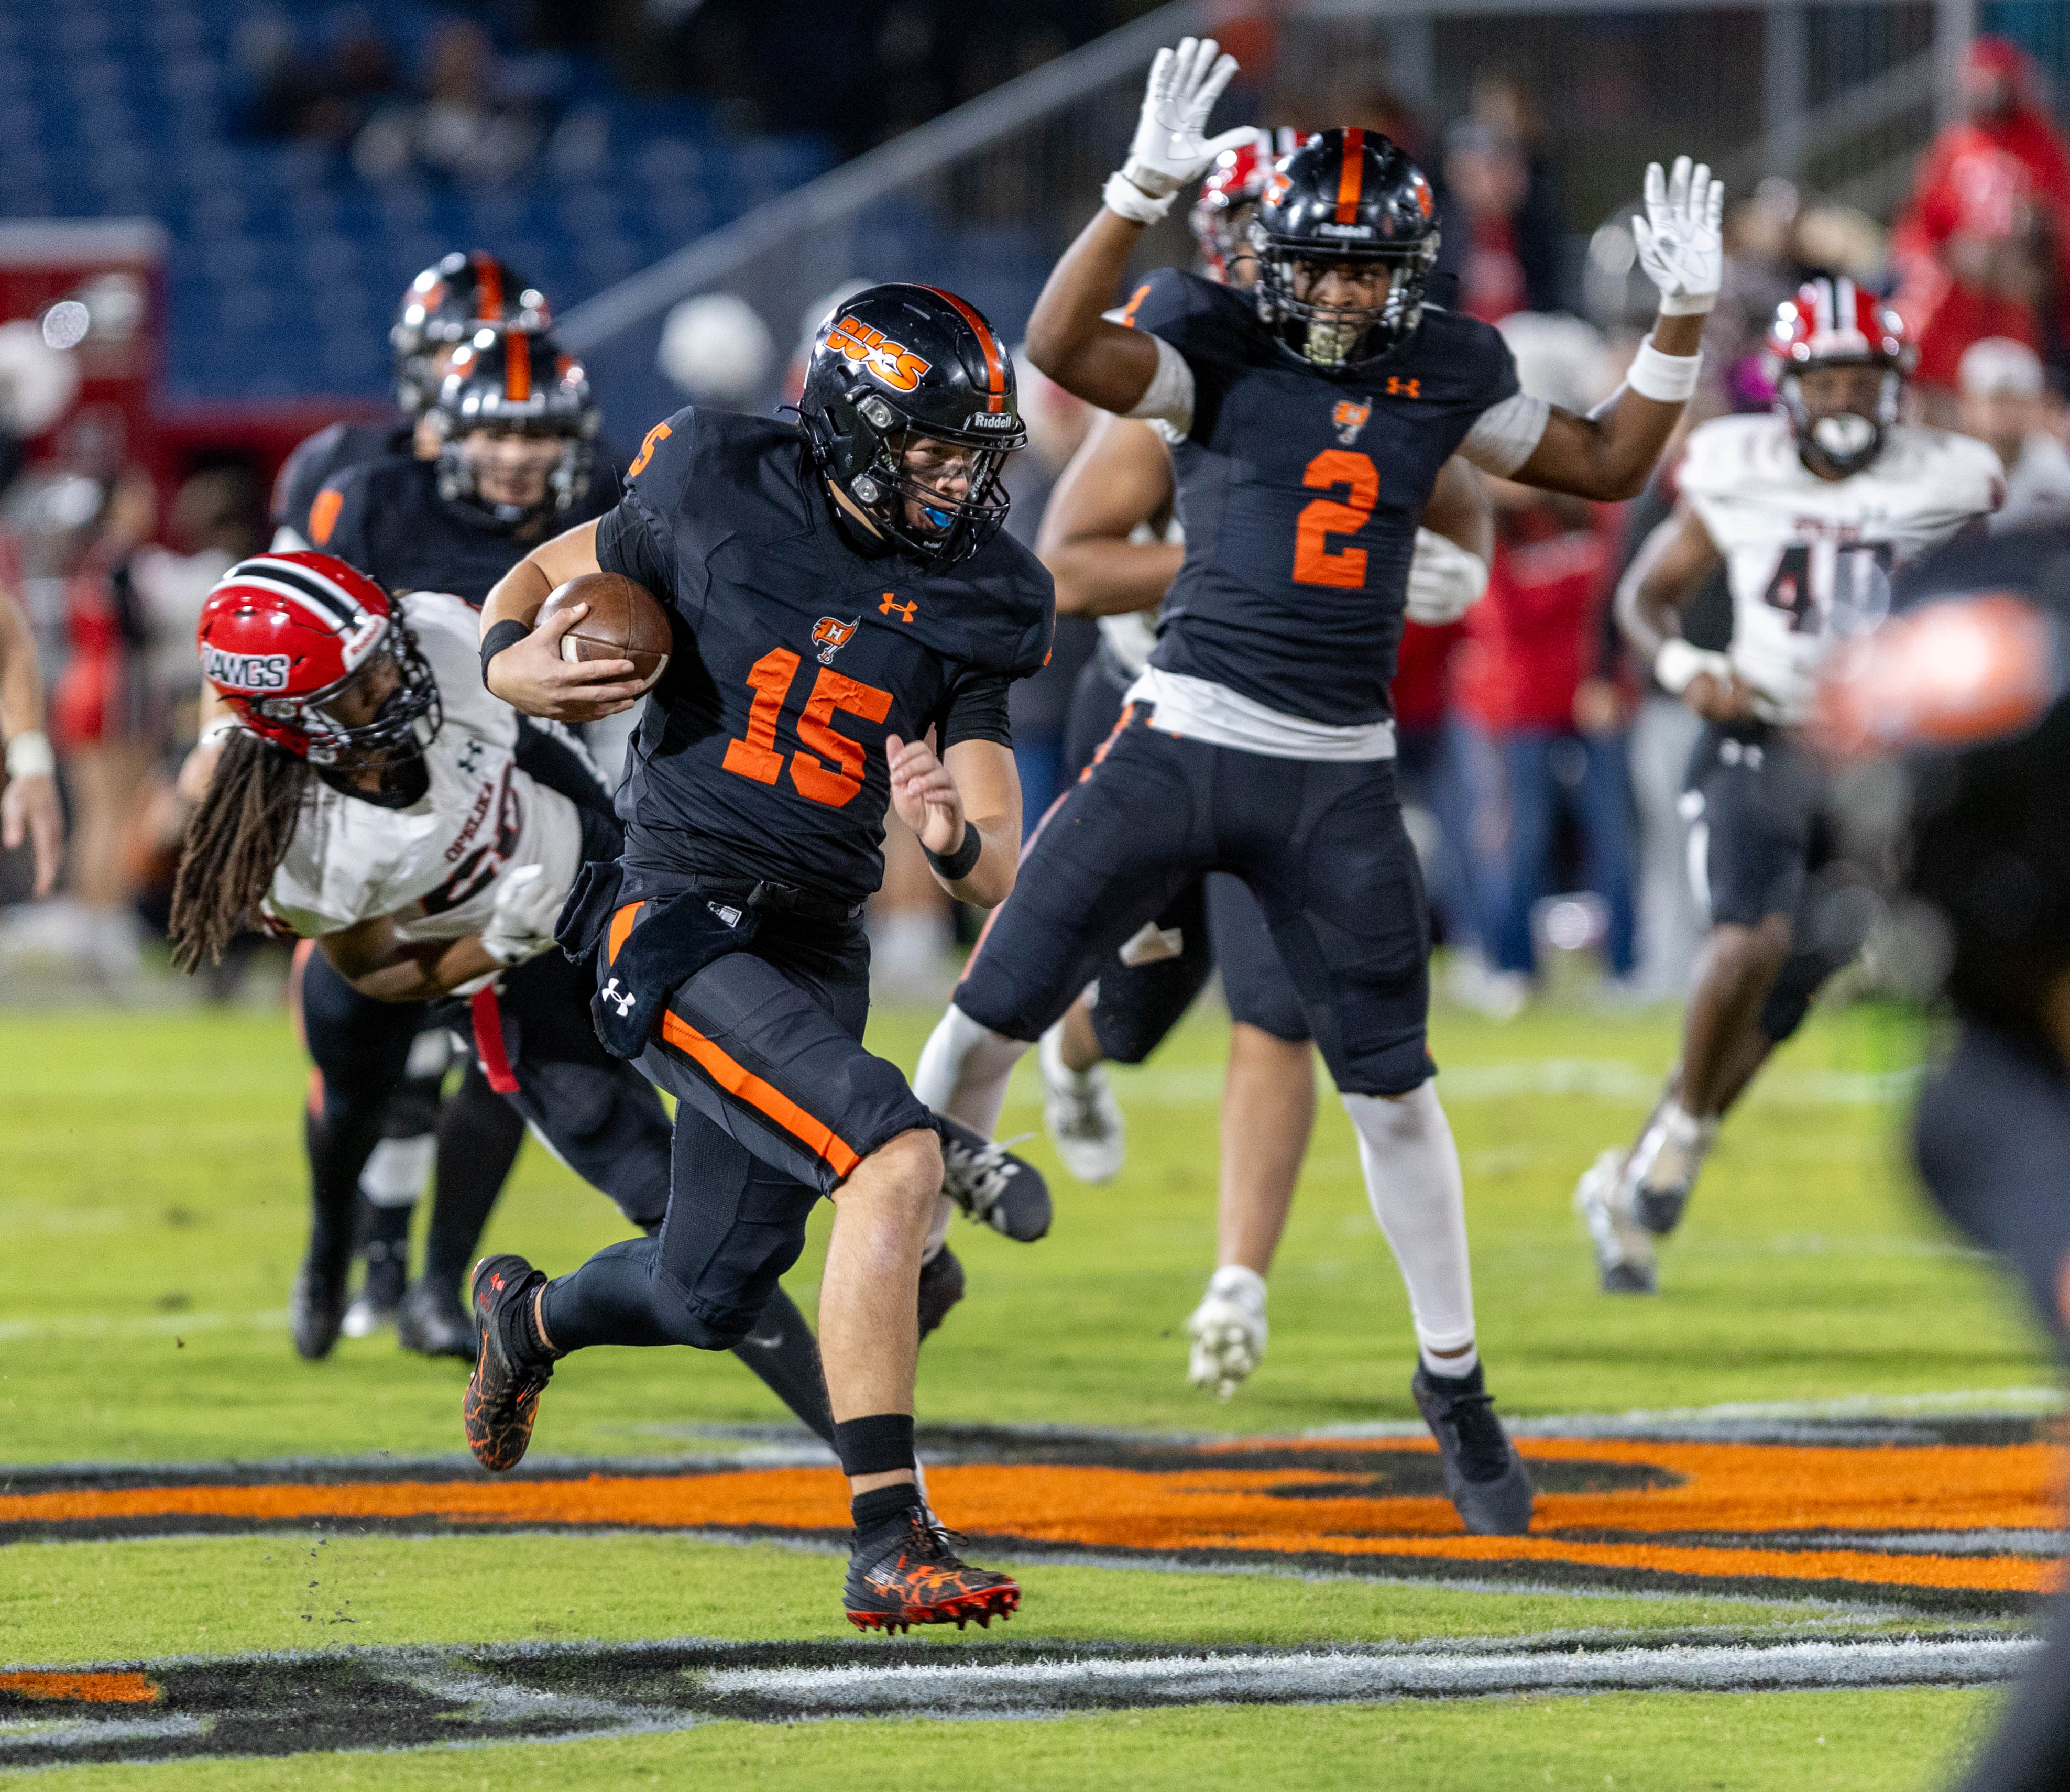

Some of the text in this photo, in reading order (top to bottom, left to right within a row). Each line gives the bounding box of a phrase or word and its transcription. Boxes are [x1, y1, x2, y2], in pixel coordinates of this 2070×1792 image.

[824, 315, 932, 391] BUCS
[975, 414, 1011, 428] Riddell
[1293, 449, 1379, 588] 2
[825, 624, 845, 642] H
[722, 648, 893, 807] 15
